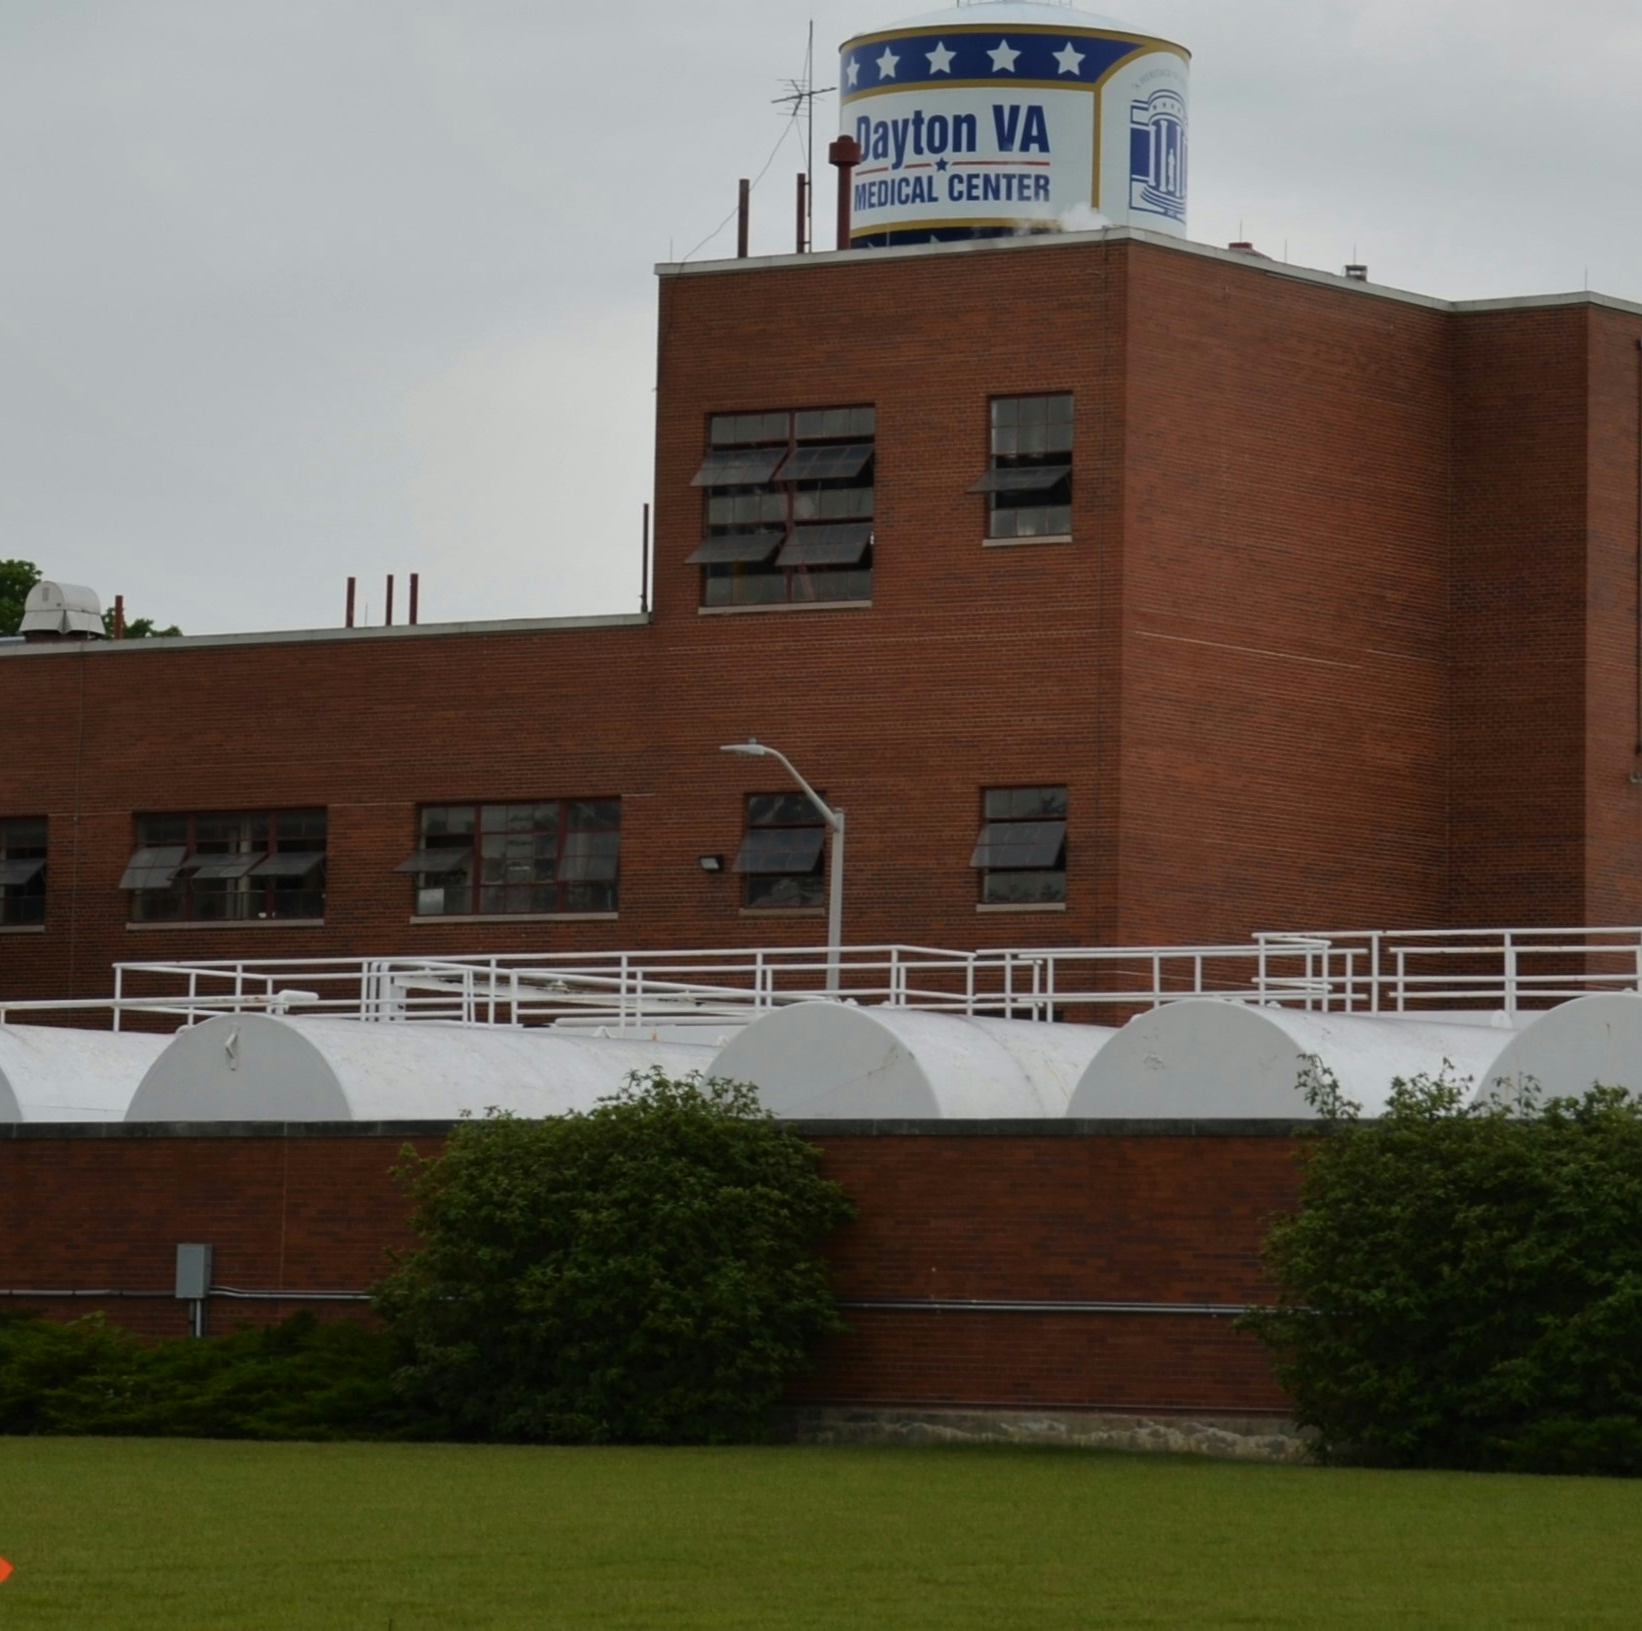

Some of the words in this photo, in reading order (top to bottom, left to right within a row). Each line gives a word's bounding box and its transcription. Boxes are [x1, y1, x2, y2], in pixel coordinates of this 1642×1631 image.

[856, 109, 977, 170] Dayton
[991, 104, 1051, 153] VA
[853, 174, 940, 212] MEDICAL
[947, 172, 1051, 203] CENTER
